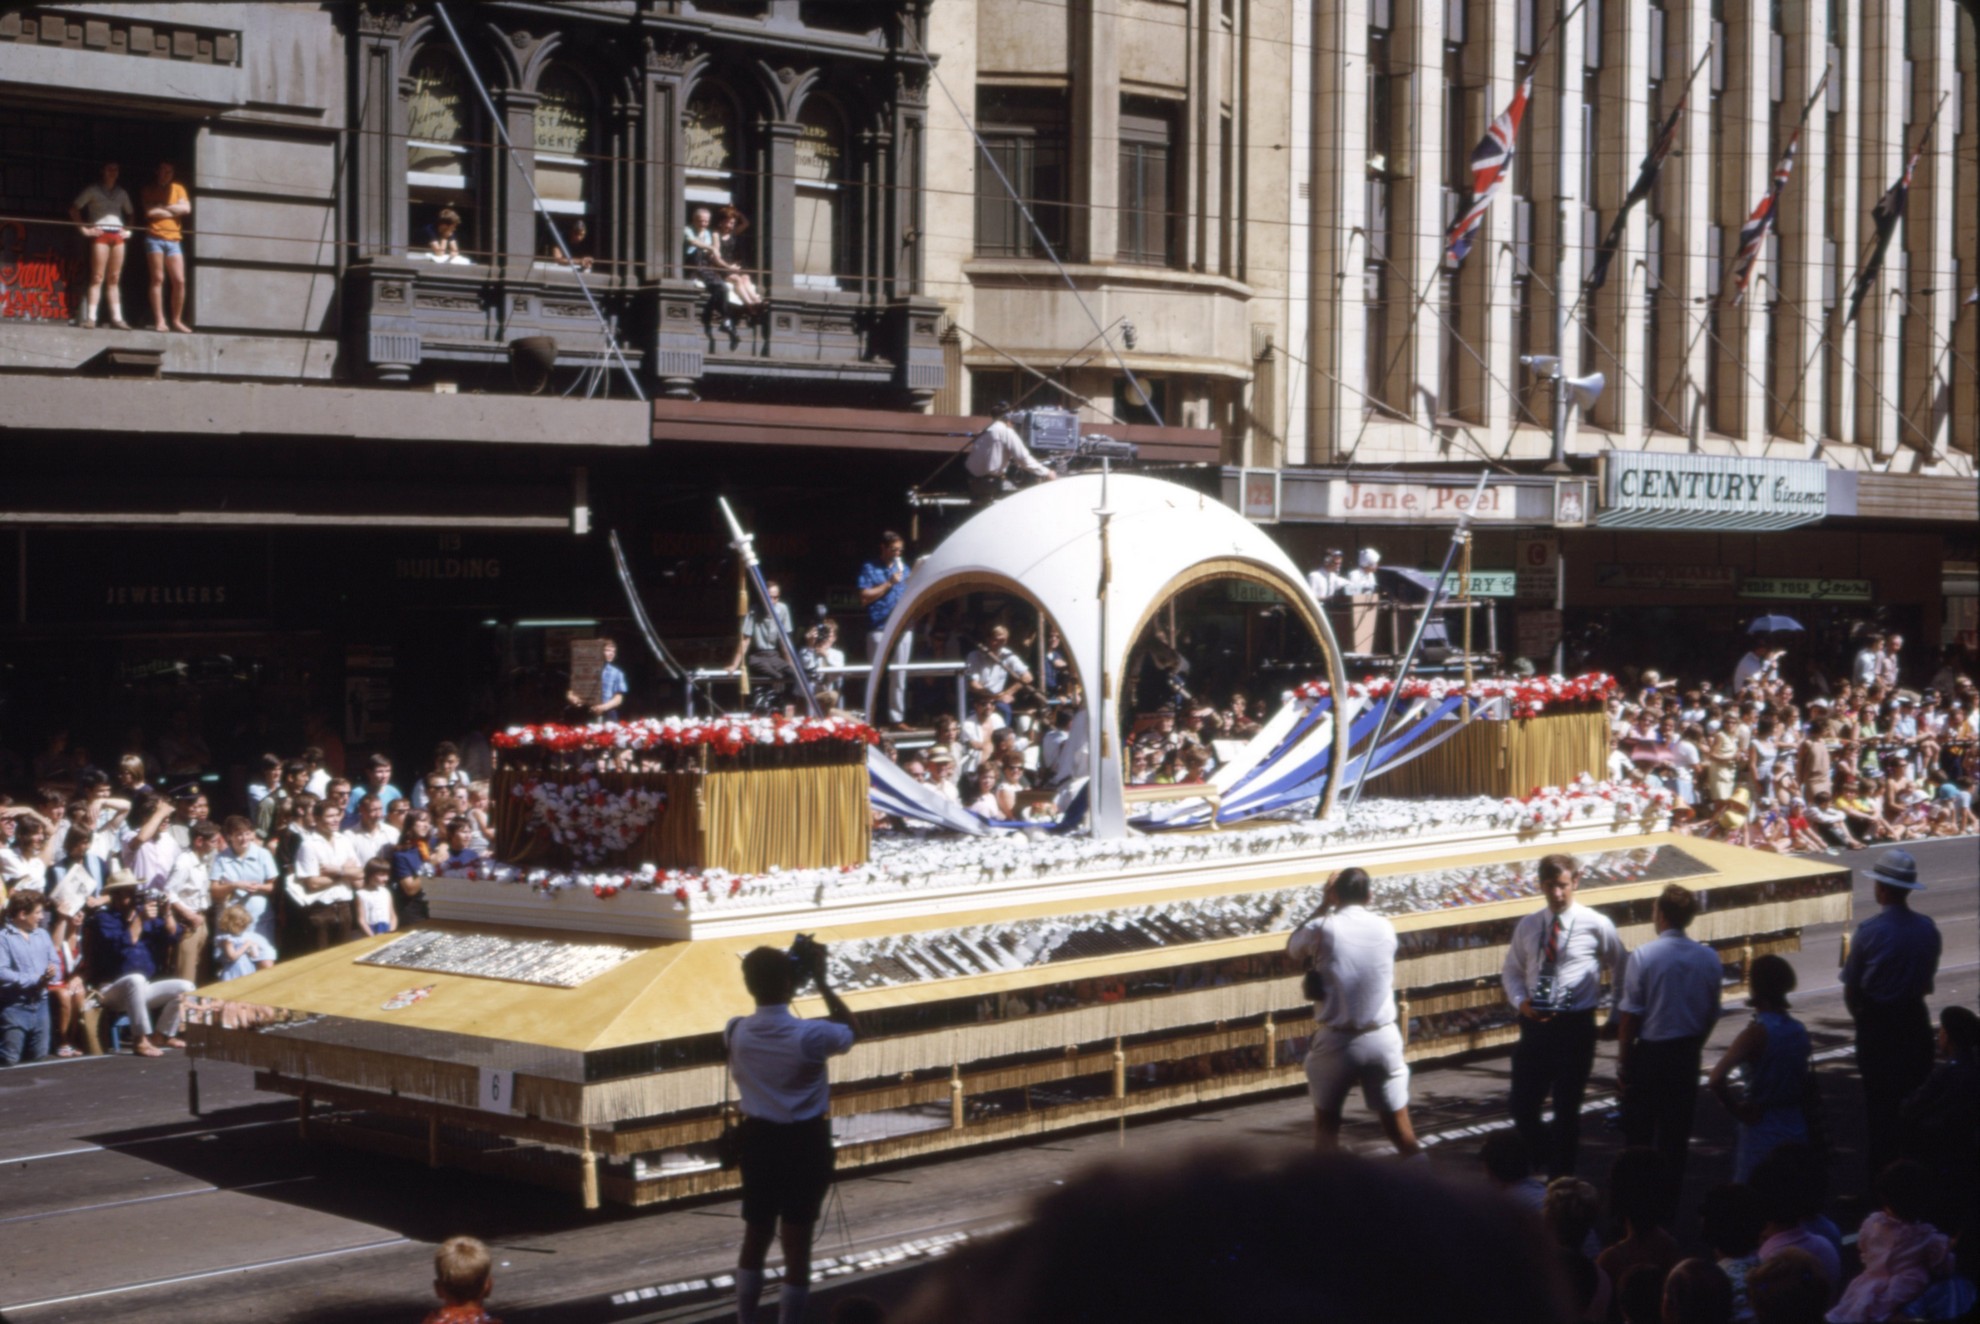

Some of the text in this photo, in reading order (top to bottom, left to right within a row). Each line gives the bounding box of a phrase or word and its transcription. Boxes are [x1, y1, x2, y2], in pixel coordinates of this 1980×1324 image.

[1344, 484, 1500, 511] Jane Peel
[1620, 469, 1826, 504] CENTURY Cinema
[396, 558, 500, 578] BUILDING
[106, 586, 225, 603] JEWELLERS
[492, 1073, 500, 1101] 6
